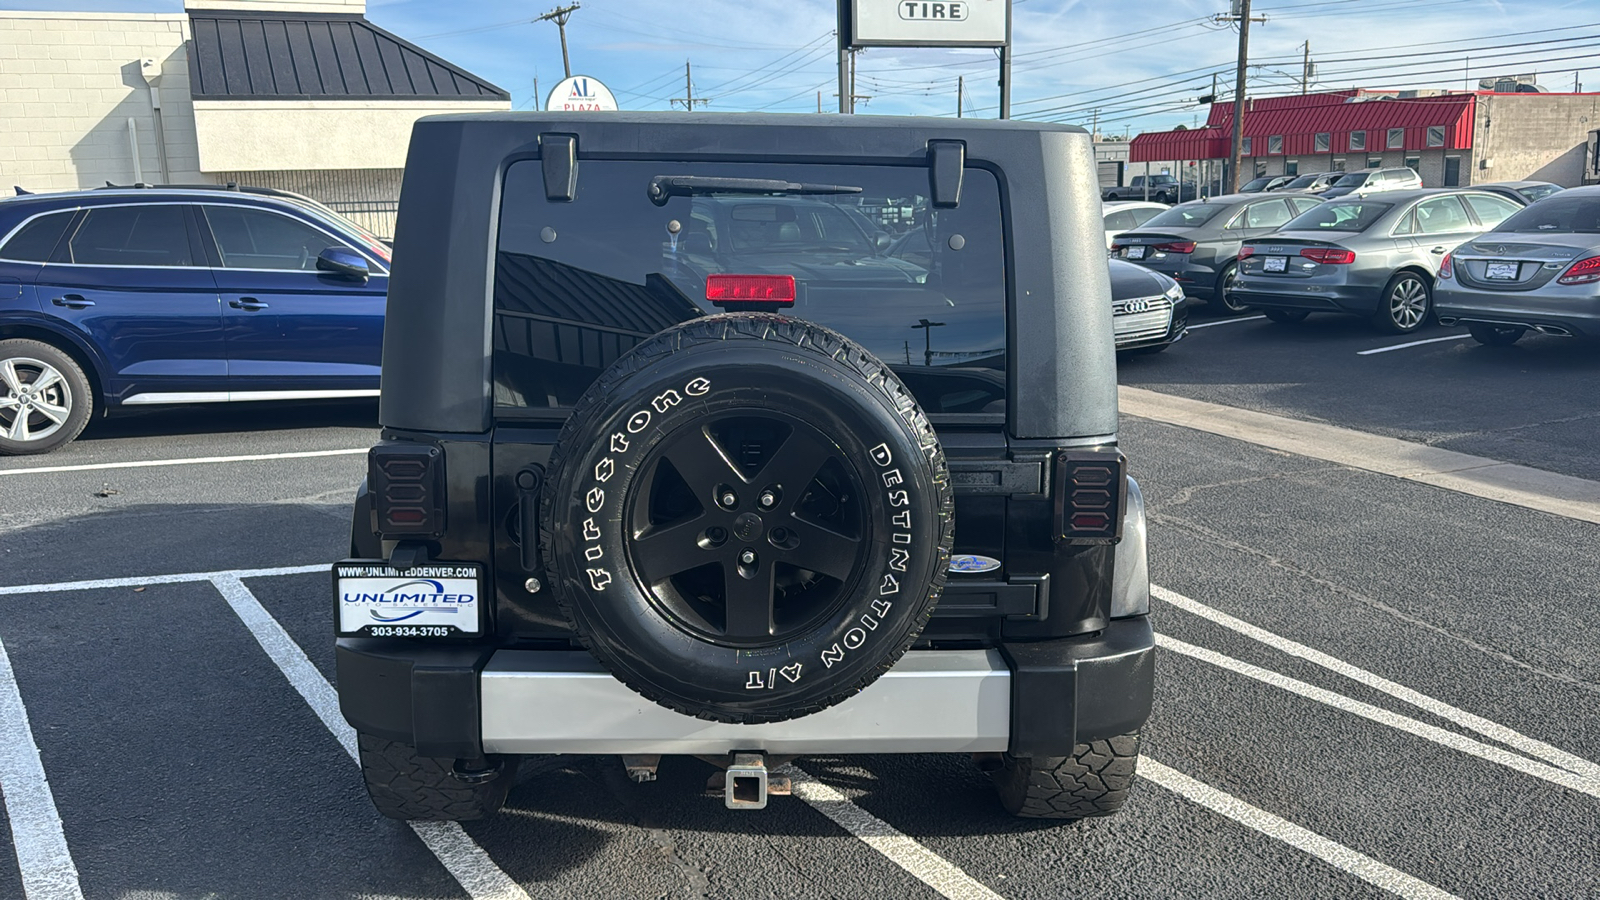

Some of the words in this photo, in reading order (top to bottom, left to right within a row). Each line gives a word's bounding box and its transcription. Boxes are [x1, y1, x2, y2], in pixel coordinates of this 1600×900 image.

[905, 3, 961, 18] TIRE
[568, 78, 595, 97] AL
[564, 103, 600, 111] PLAZA
[821, 443, 912, 668] DESTINATION
[344, 593, 474, 603] UNLIMITED
[371, 626, 448, 637] 303-934-3705
[745, 662, 803, 690] A/T
